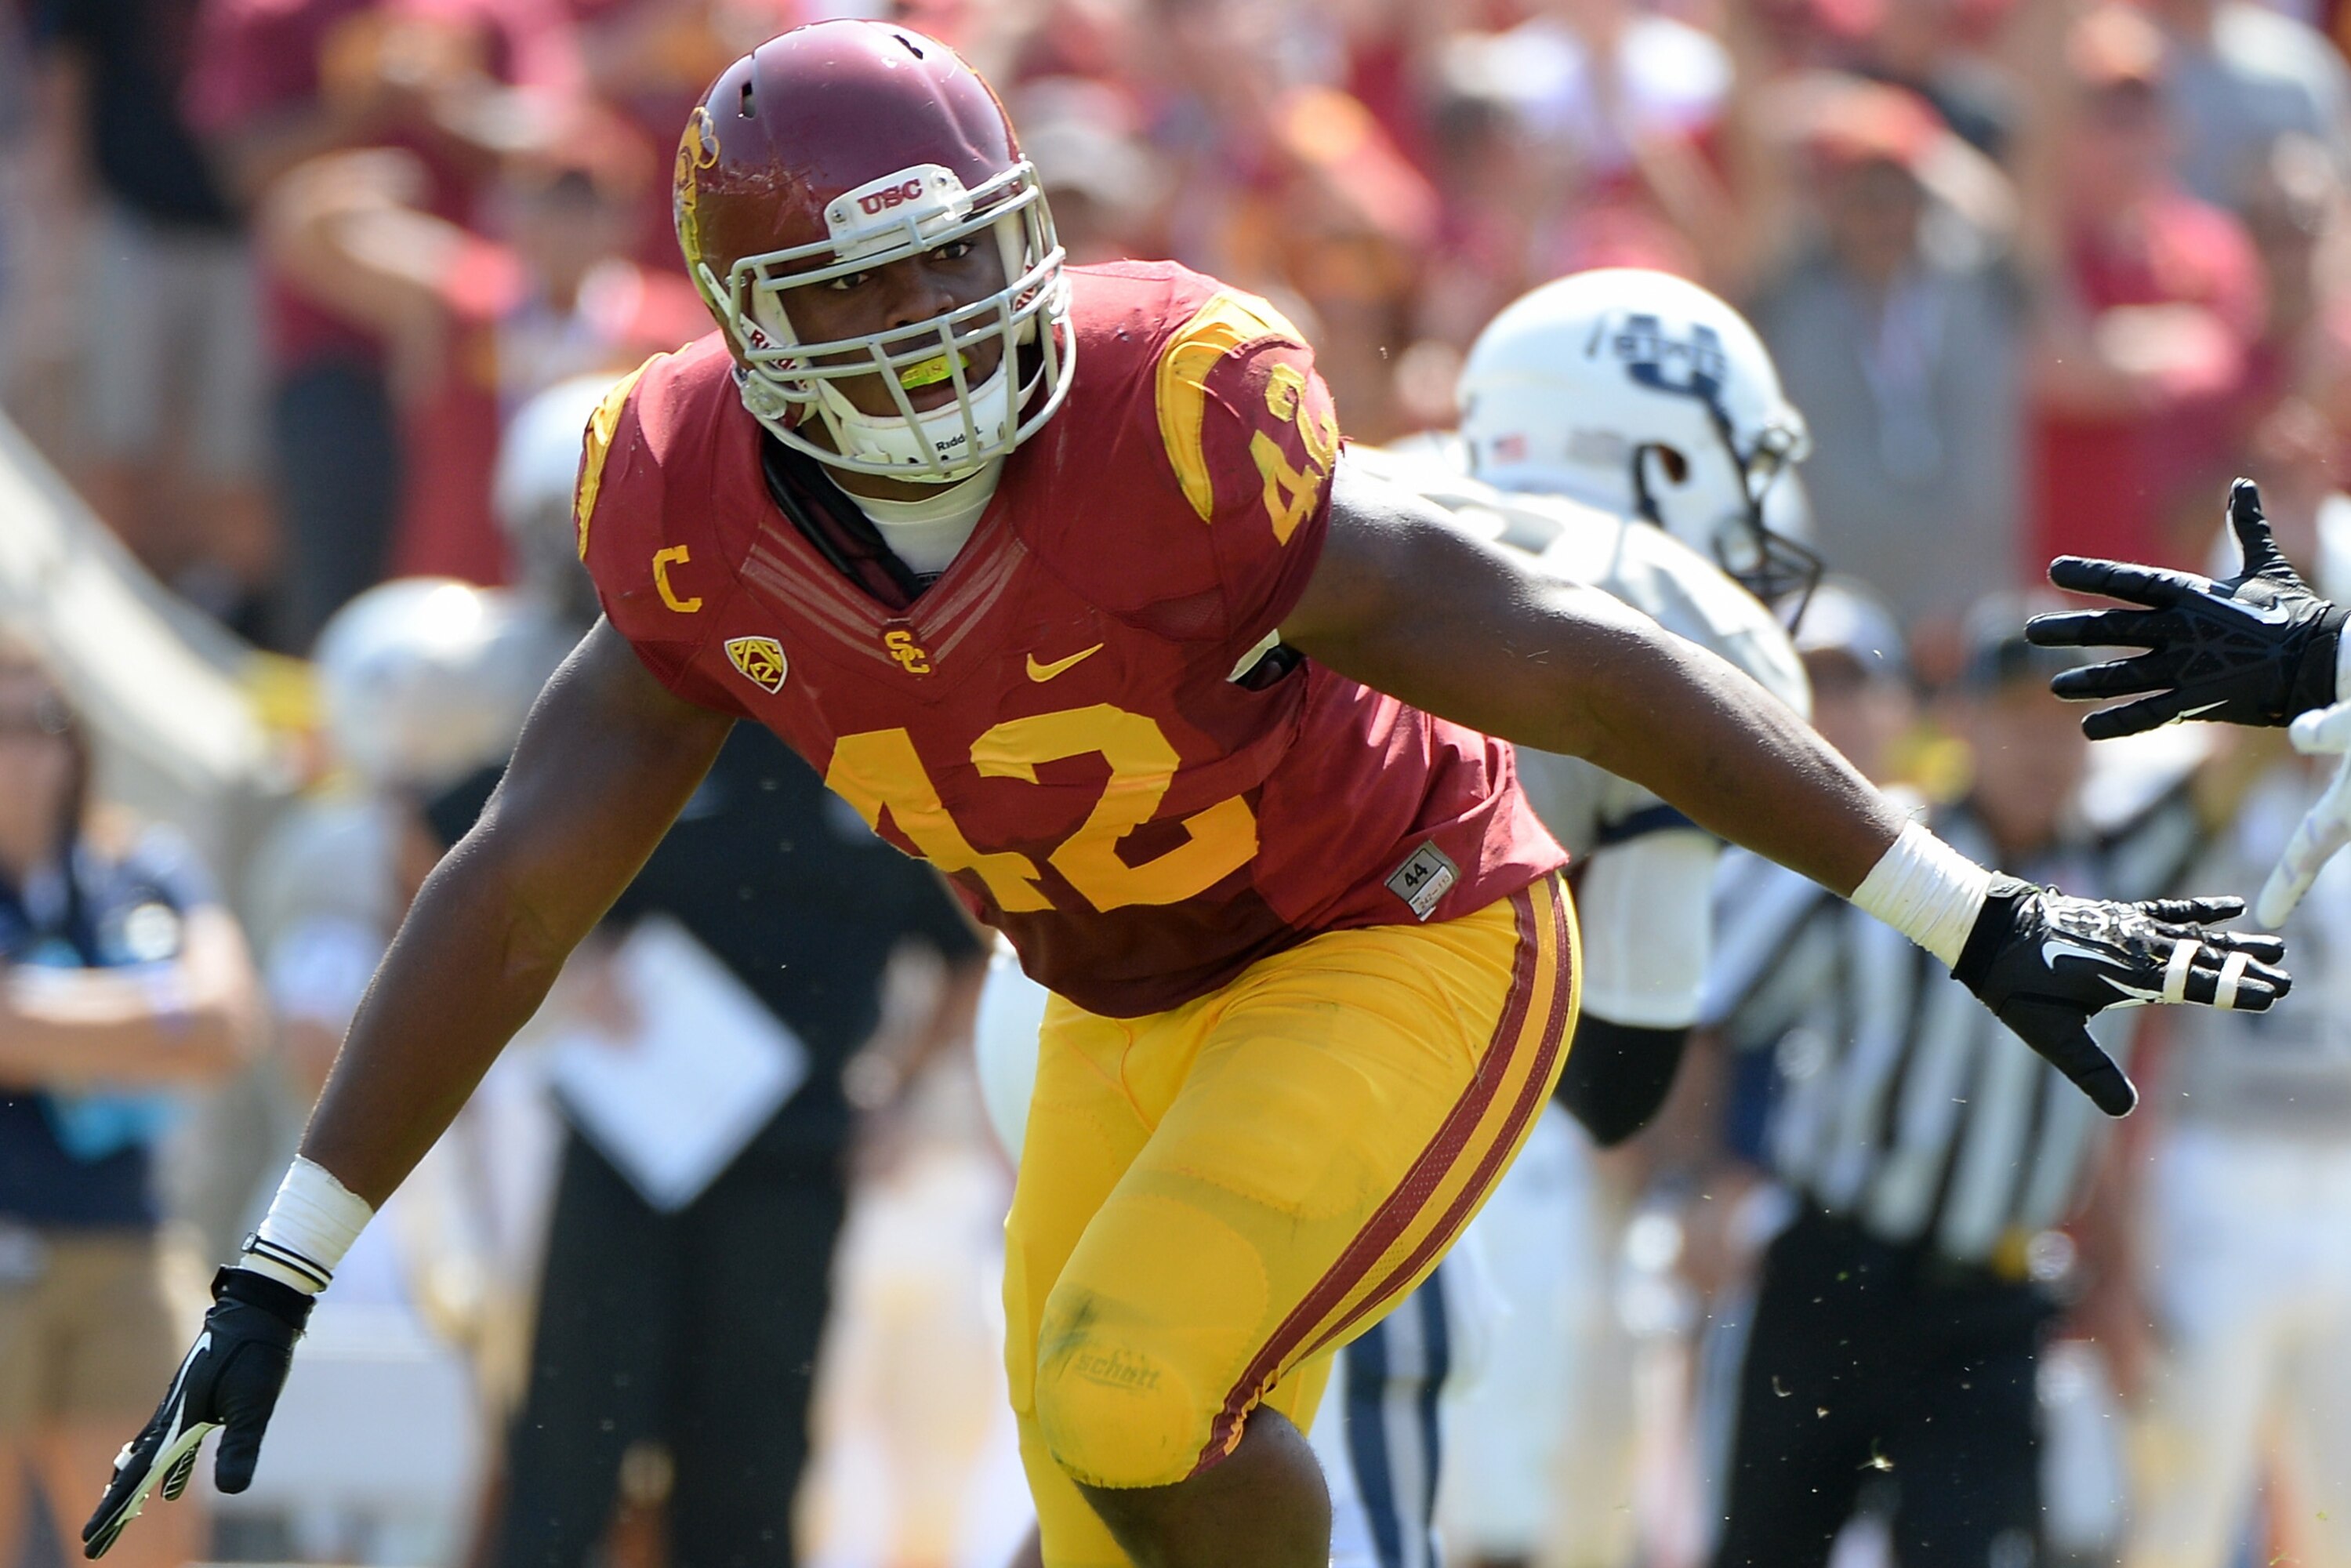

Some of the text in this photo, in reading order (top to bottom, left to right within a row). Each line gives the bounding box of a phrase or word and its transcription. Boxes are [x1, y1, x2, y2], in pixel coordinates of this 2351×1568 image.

[857, 178, 923, 215] USC
[652, 545, 702, 613] C
[728, 639, 782, 673] PAC
[884, 630, 931, 673] SC
[824, 702, 1259, 913] 42
[1404, 862, 1428, 887] 44
